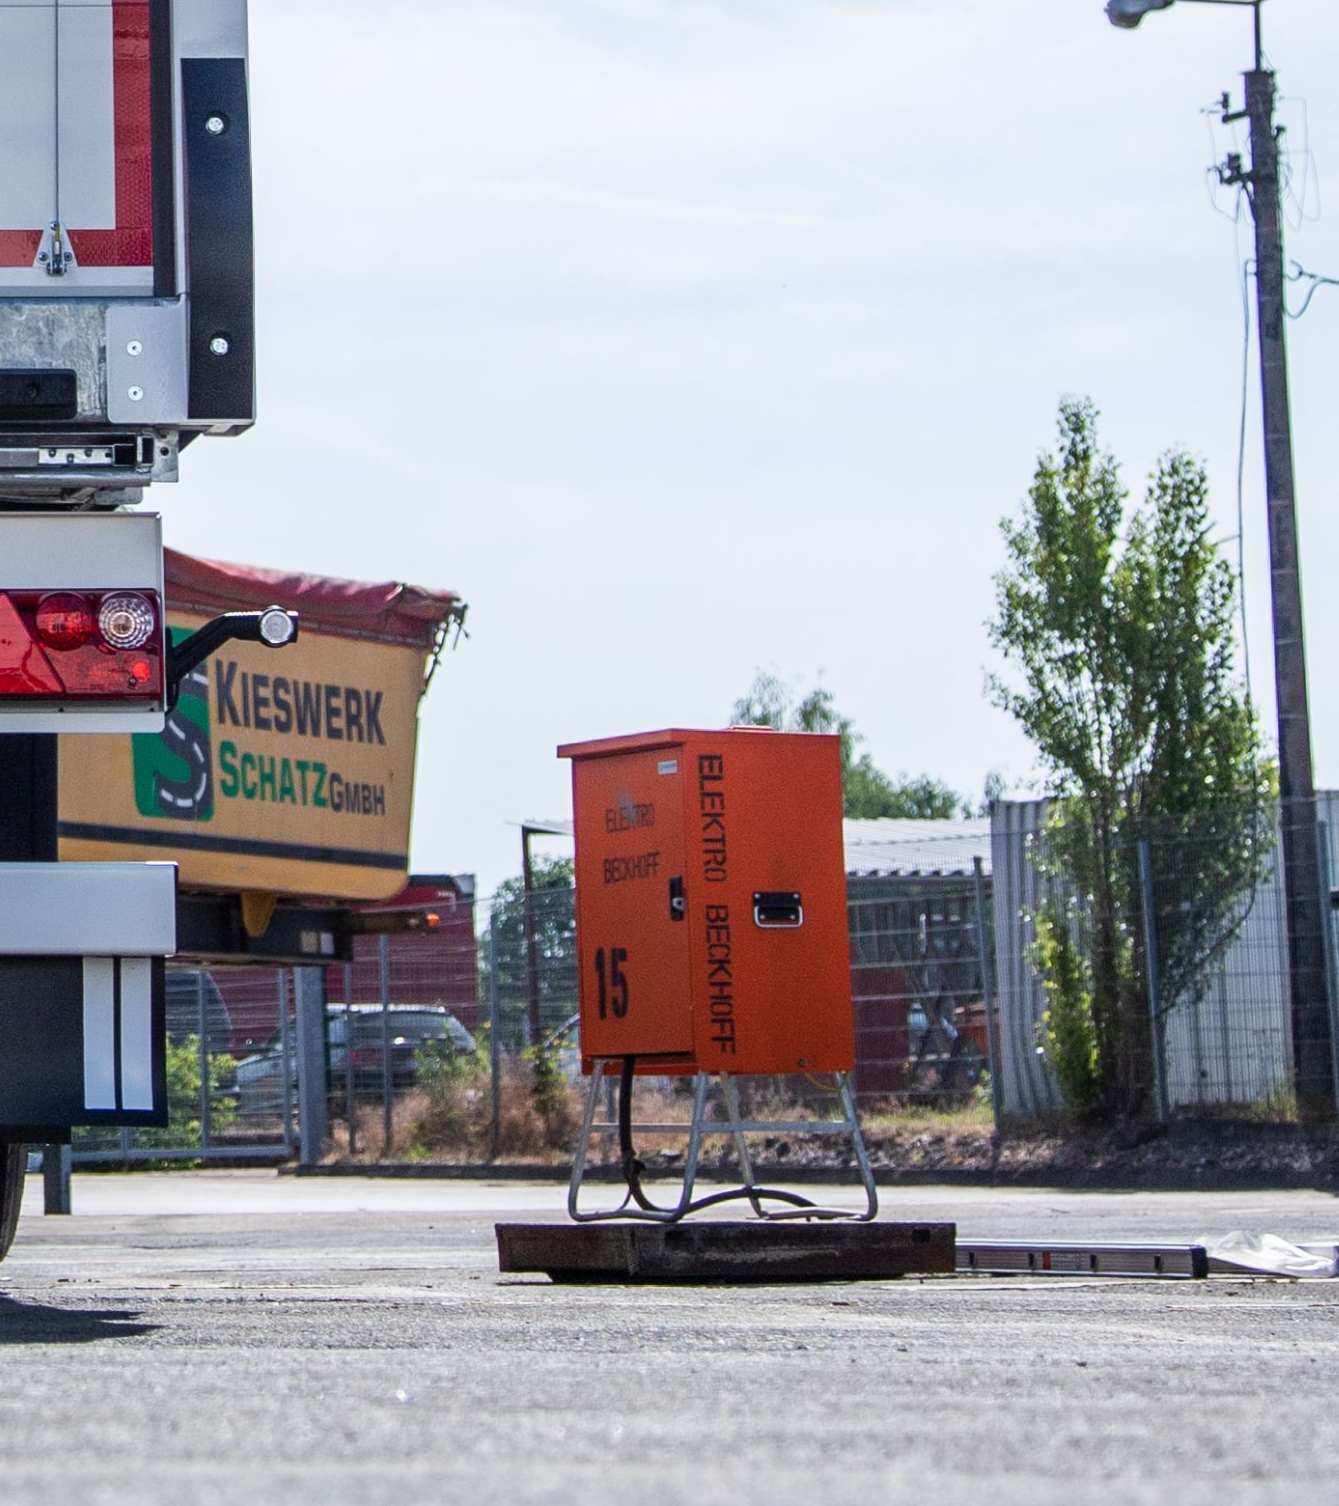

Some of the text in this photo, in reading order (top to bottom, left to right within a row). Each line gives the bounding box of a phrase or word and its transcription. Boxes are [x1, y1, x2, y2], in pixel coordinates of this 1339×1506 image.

[214, 659, 386, 745] KIESWERK
[698, 754, 736, 1053] ELEKTRO BECKHOFF
[594, 947, 628, 1019] 15
